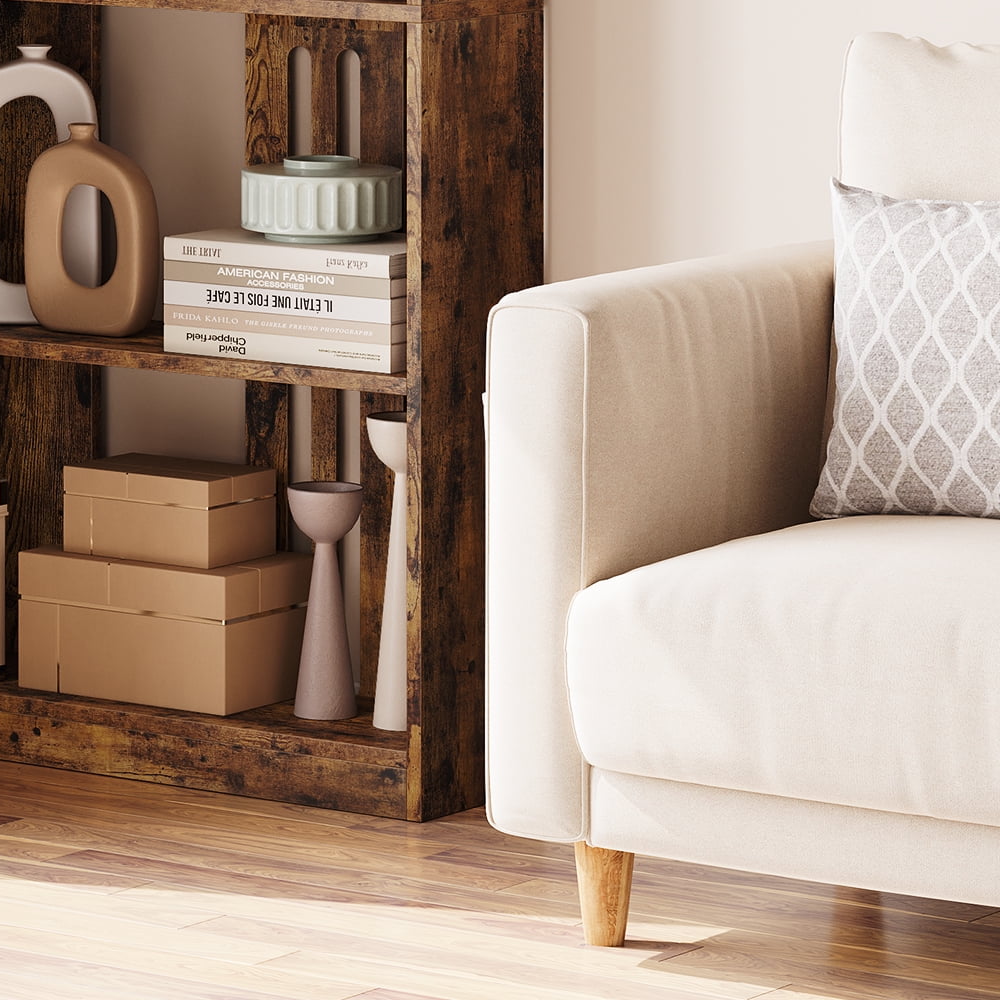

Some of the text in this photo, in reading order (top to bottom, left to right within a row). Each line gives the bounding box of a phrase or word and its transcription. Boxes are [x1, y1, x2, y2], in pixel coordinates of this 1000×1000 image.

[217, 267, 334, 285] AMERICAN FASHION
[247, 279, 304, 291] ACCESSORIES
[206, 289, 333, 312] IL ÉTAIT UNE FOIS LE CAFÉ
[173, 312, 201, 321] FRIDA
[205, 315, 238, 325] KAHLO
[290, 323, 318, 332] FREUND
[320, 325, 373, 336] PHOTOGRAPHS
[187, 333, 247, 346] Chipperfield
[219, 344, 246, 354] David
